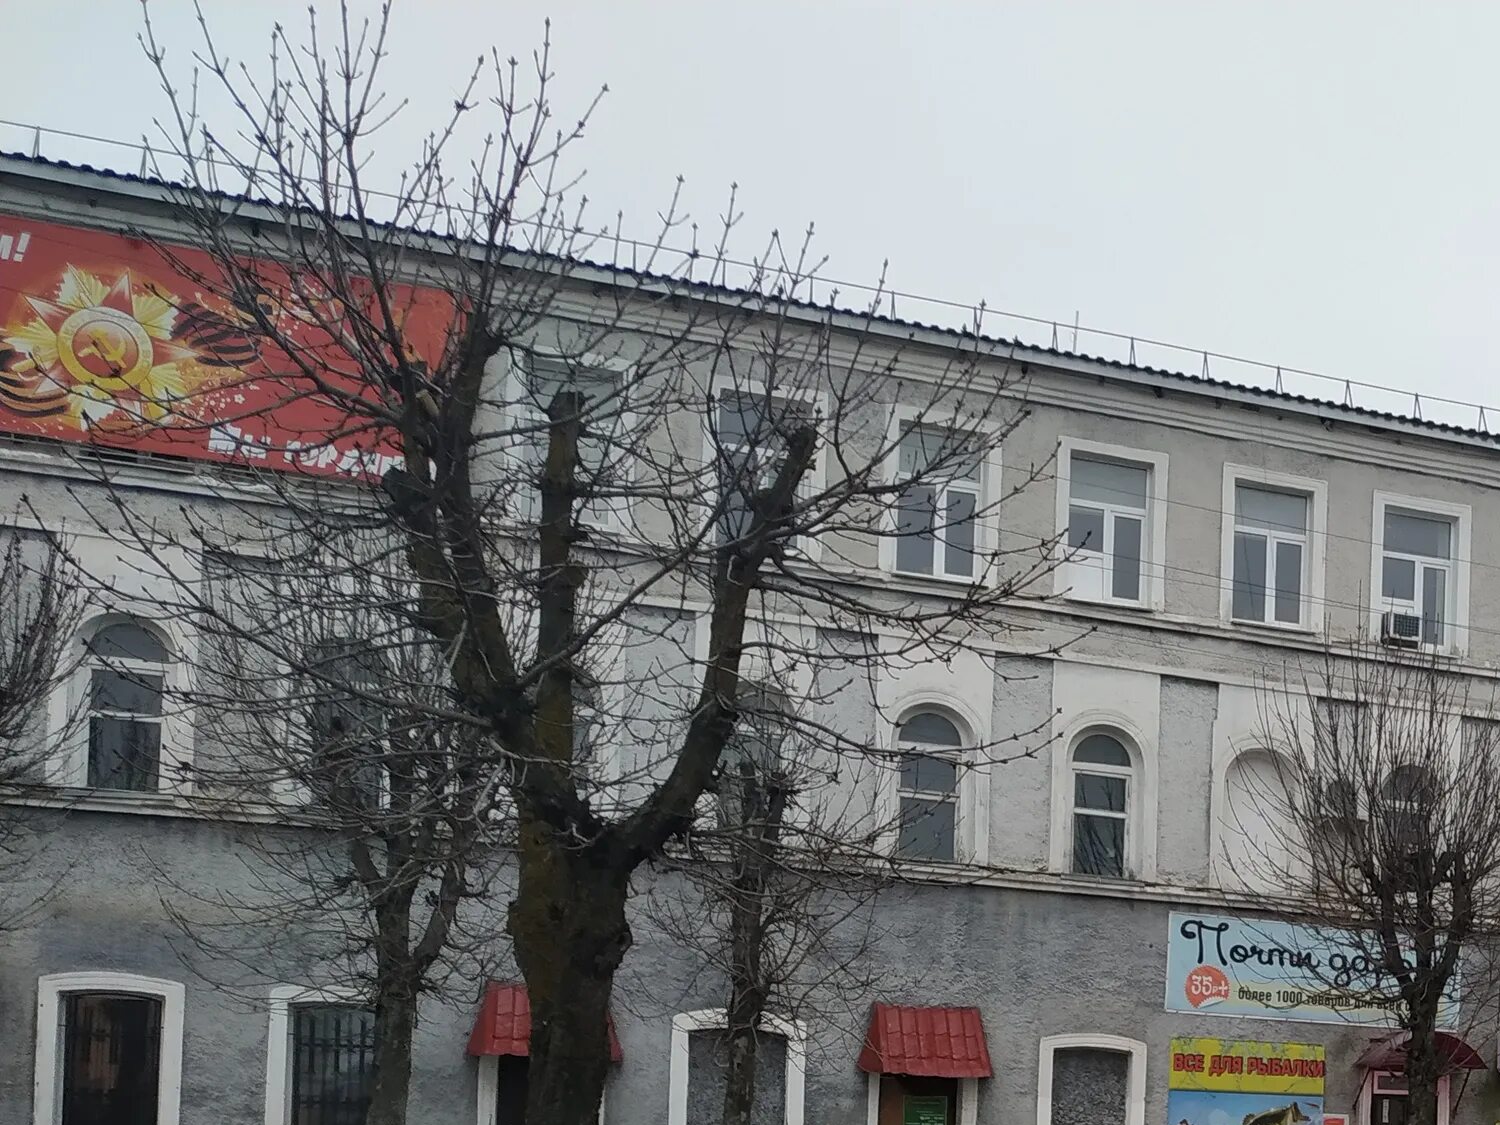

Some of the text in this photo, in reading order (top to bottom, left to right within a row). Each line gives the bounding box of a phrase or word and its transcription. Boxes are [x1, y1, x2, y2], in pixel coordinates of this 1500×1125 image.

[1181, 920, 1320, 969] Почти
[1238, 986, 1272, 1002] более
[1276, 990, 1303, 1005] 1000
[1173, 1054, 1325, 1078] ВСЕ ДЛЯ РЫБАЛКИ
